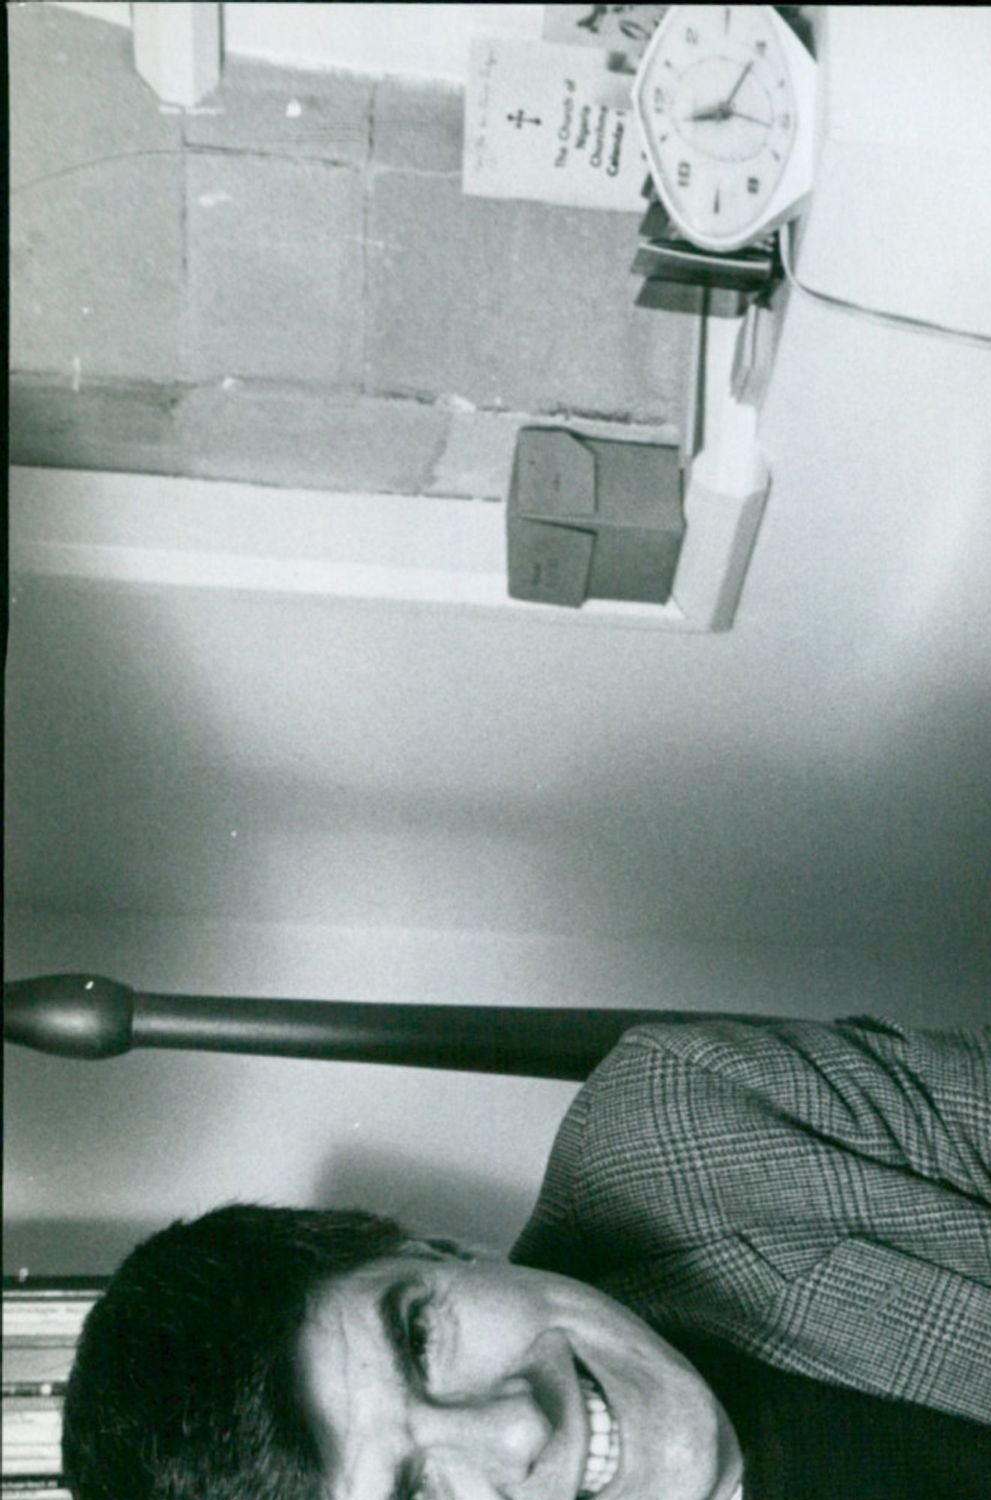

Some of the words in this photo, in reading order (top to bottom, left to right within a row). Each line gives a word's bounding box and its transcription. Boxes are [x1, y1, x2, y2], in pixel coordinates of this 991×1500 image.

[564, 78, 577, 92] of
[557, 97, 575, 141] Church
[574, 104, 592, 149] Nigeria
[554, 146, 569, 168] The
[605, 122, 625, 177] Calendar
